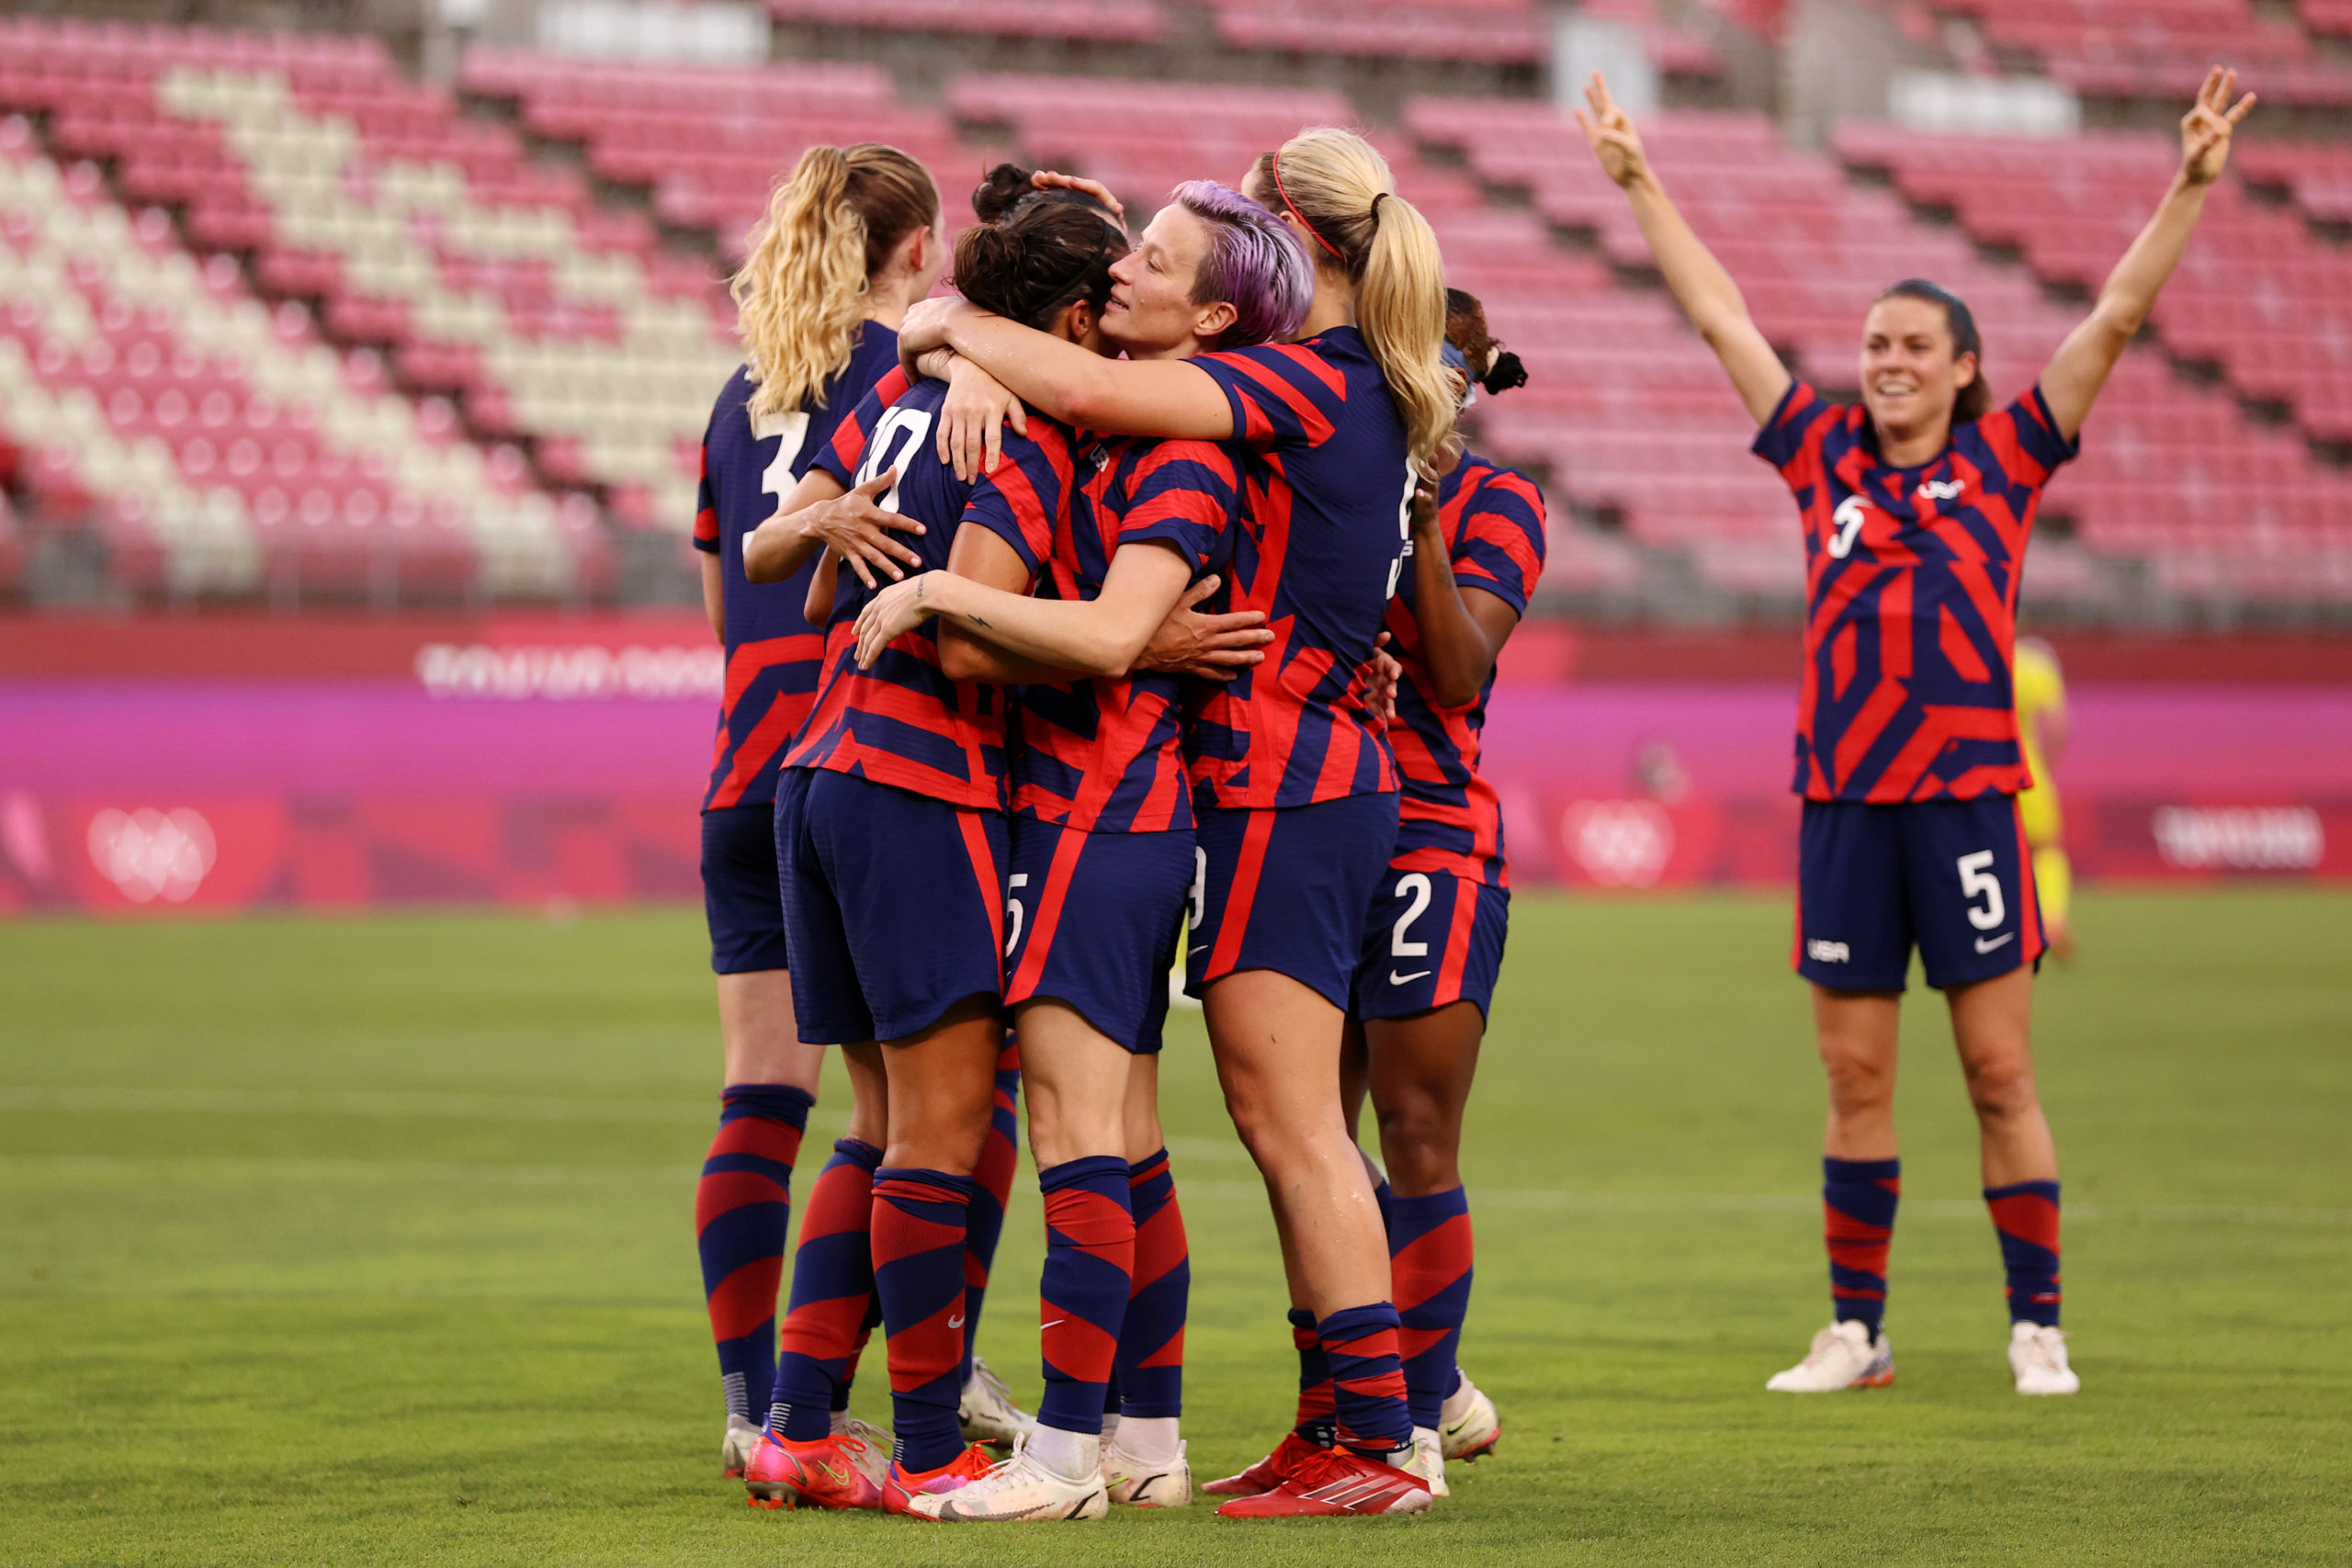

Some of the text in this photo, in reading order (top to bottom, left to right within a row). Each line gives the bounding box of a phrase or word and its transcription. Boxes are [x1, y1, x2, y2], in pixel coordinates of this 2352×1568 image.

[742, 411, 810, 556] 3
[1391, 873, 1431, 956] 2
[1957, 850, 2006, 931] 5
[1807, 938, 1850, 964] USA
